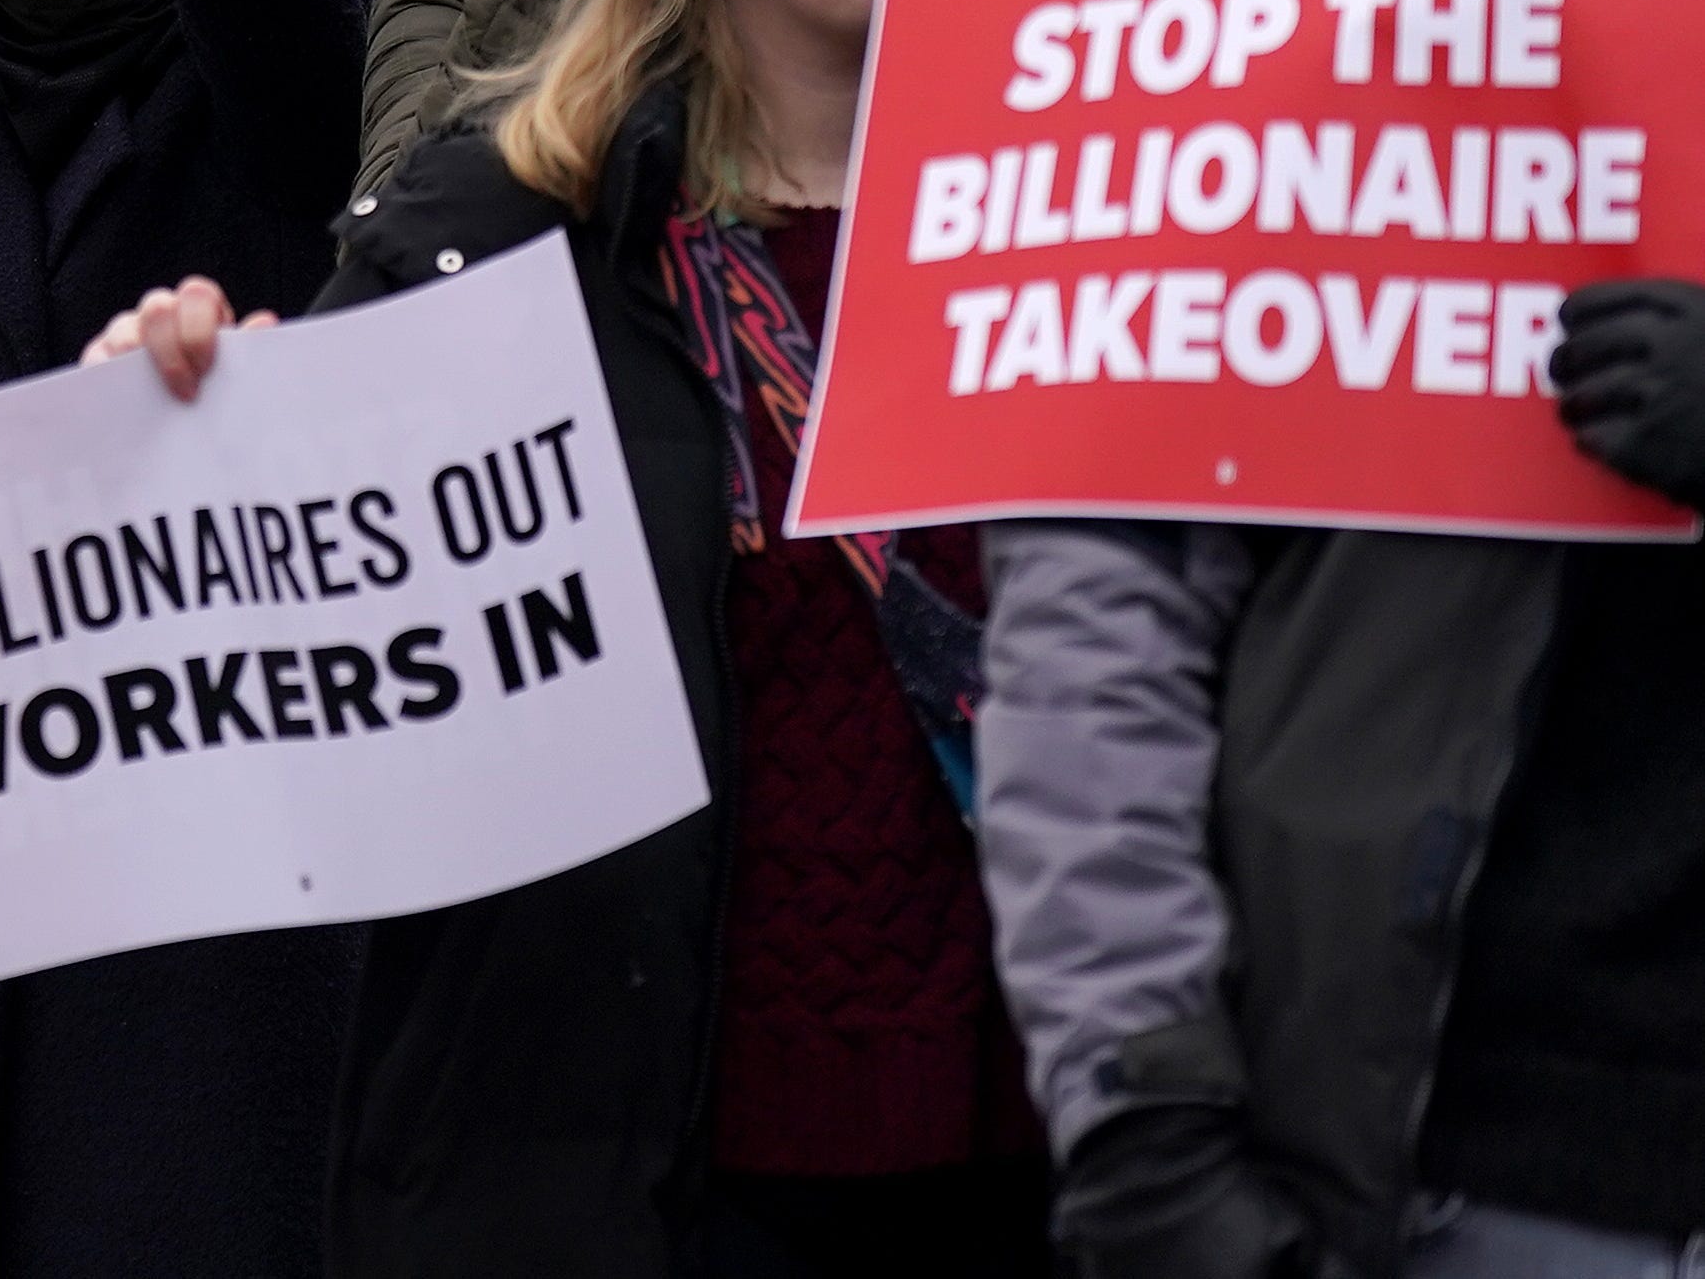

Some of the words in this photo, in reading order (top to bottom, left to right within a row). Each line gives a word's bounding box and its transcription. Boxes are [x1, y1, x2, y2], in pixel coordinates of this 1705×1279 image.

[908, 121, 1647, 264] BILLIONAIRE
[944, 270, 1565, 397] TAKEOVER
[431, 418, 583, 565] OUT
[482, 571, 602, 695] IN
